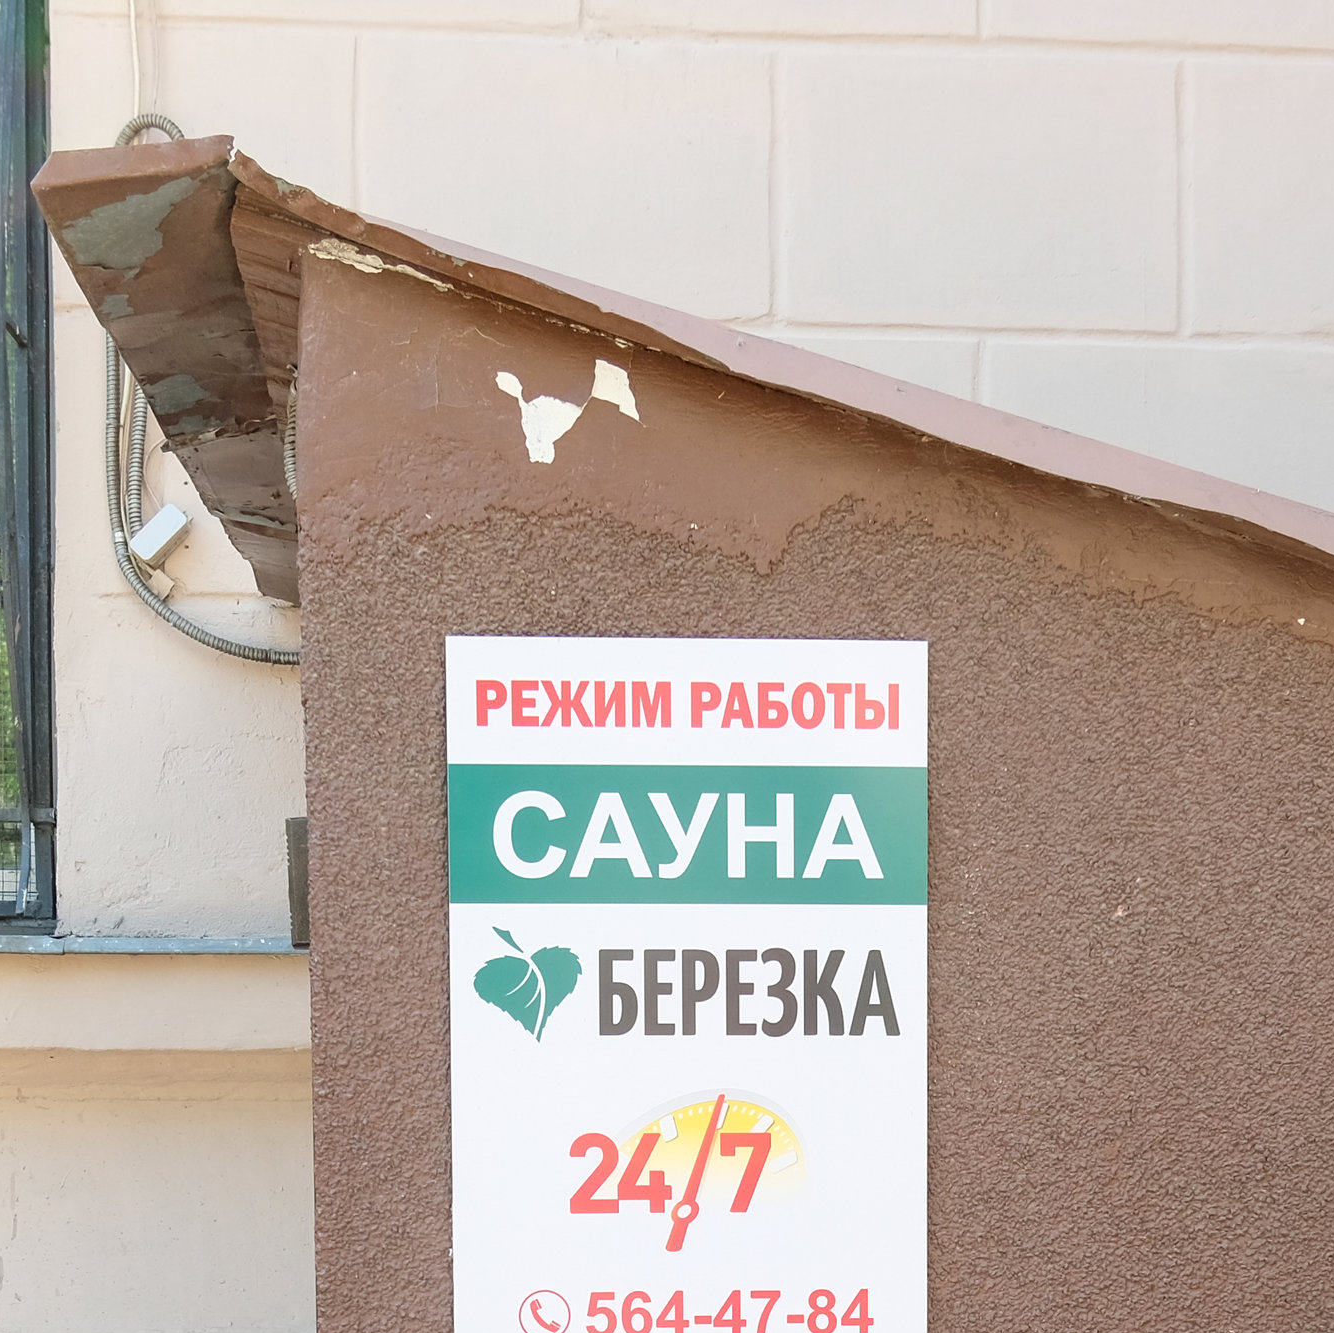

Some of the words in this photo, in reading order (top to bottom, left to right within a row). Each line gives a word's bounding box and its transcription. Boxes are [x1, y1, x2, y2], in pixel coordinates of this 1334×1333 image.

[474, 679, 672, 728] РЕЖИМ
[690, 681, 901, 730] РАБОТЫ
[492, 790, 885, 879] САУНА
[598, 947, 901, 1038] БЕРЕЗКА
[569, 1094, 771, 1252] 24/7
